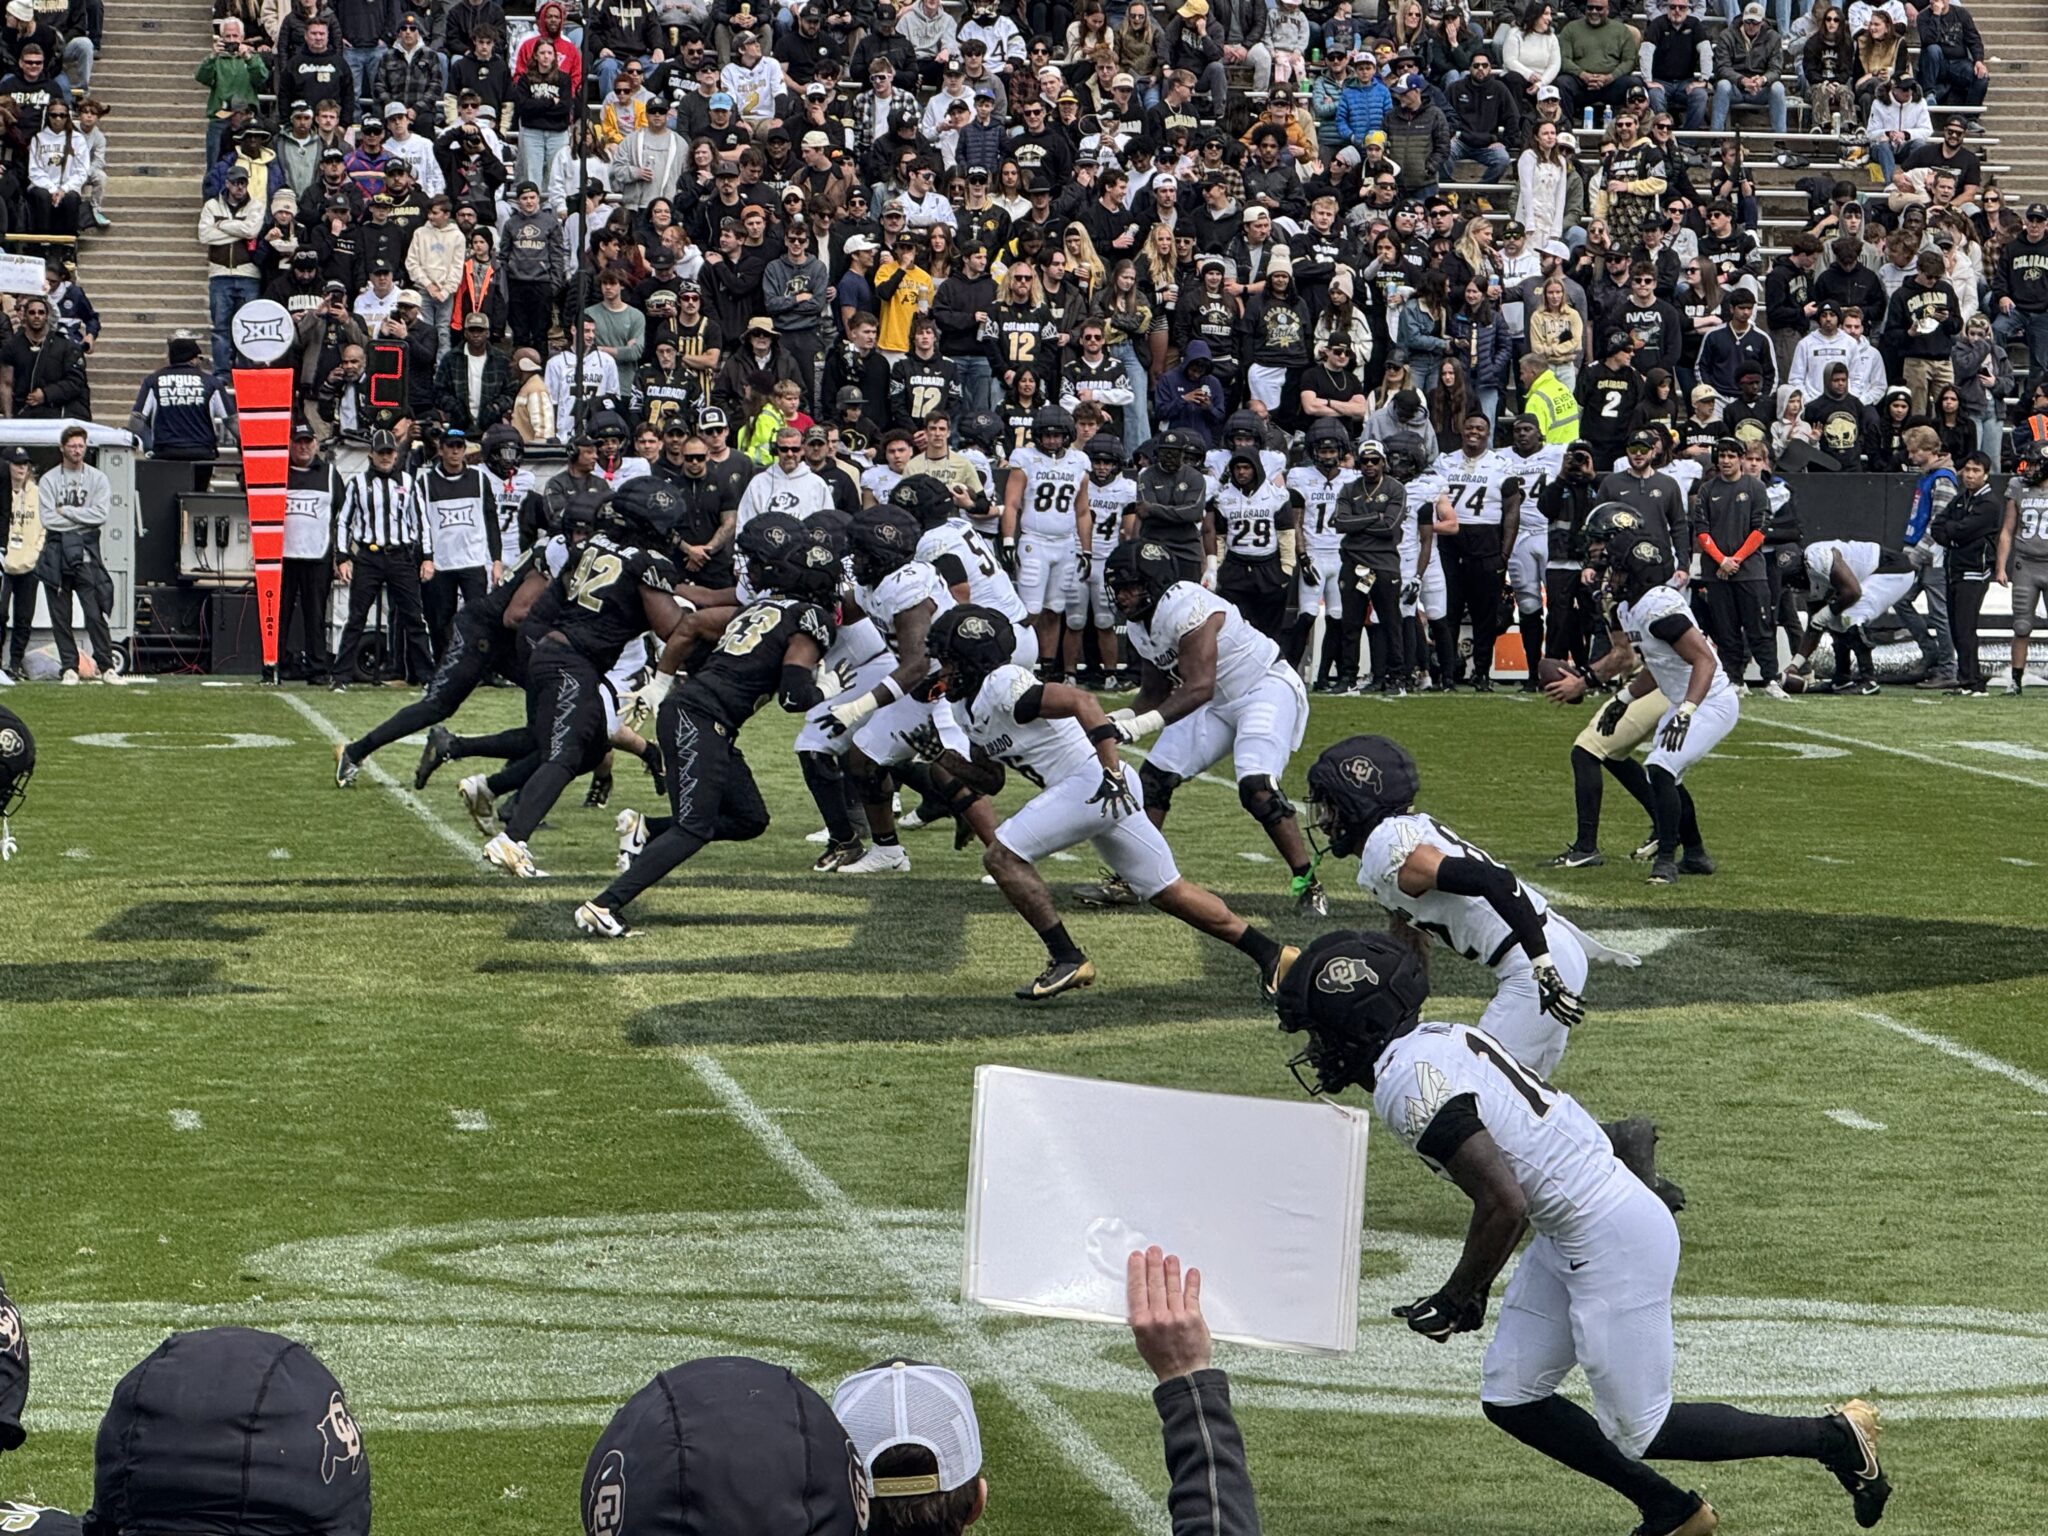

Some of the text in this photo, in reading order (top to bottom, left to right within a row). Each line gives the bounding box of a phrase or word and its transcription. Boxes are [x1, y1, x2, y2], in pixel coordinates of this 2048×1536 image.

[992, 39, 1007, 61] 4
[1625, 311, 1663, 323] NASA
[1003, 321, 1039, 332] COLORADO
[1008, 332, 1036, 361] 12
[370, 346, 403, 407] 2
[566, 374, 603, 384] CORADO
[910, 376, 944, 387] COLORADO
[158, 387, 204, 397] EVENT
[646, 386, 687, 400] COLORADO
[159, 396, 205, 407] STAFF
[911, 386, 942, 419] 12
[1601, 390, 1622, 417] 2
[1009, 416, 1034, 426] COLOR
[1036, 472, 1075, 482] COLORADO
[1447, 473, 1488, 484] COLORADO
[1034, 482, 1076, 513] 86
[1311, 492, 1338, 502] COLOR
[1447, 484, 1488, 515] 74
[1088, 499, 1119, 510] LORADO
[1229, 507, 1270, 519] COLORADO
[1231, 519, 1270, 547] 29
[568, 546, 623, 610] 92
[265, 589, 275, 638] Gilman
